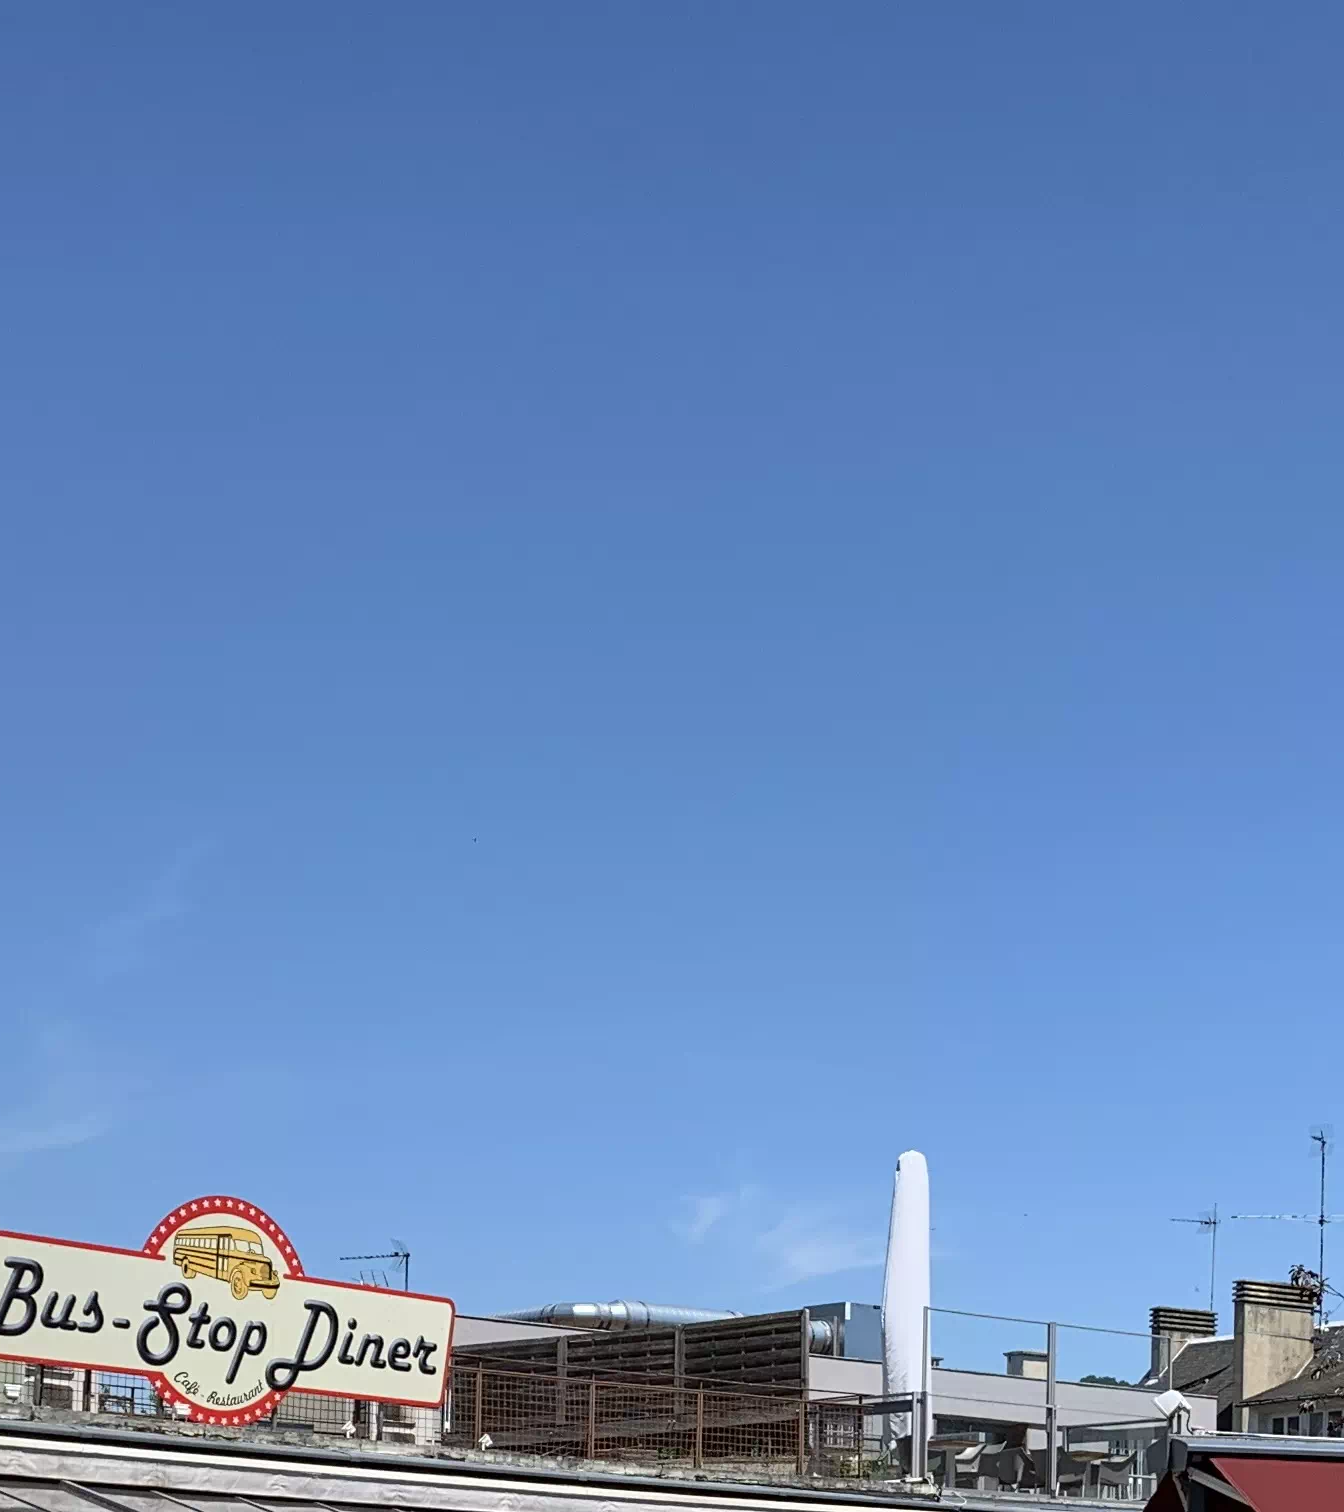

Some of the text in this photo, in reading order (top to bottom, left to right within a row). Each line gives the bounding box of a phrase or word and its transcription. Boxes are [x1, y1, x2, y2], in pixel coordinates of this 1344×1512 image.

[265, 1300, 437, 1391] Diner
[174, 1371, 199, 1396] Café
[206, 1379, 264, 1407] Restaurant
